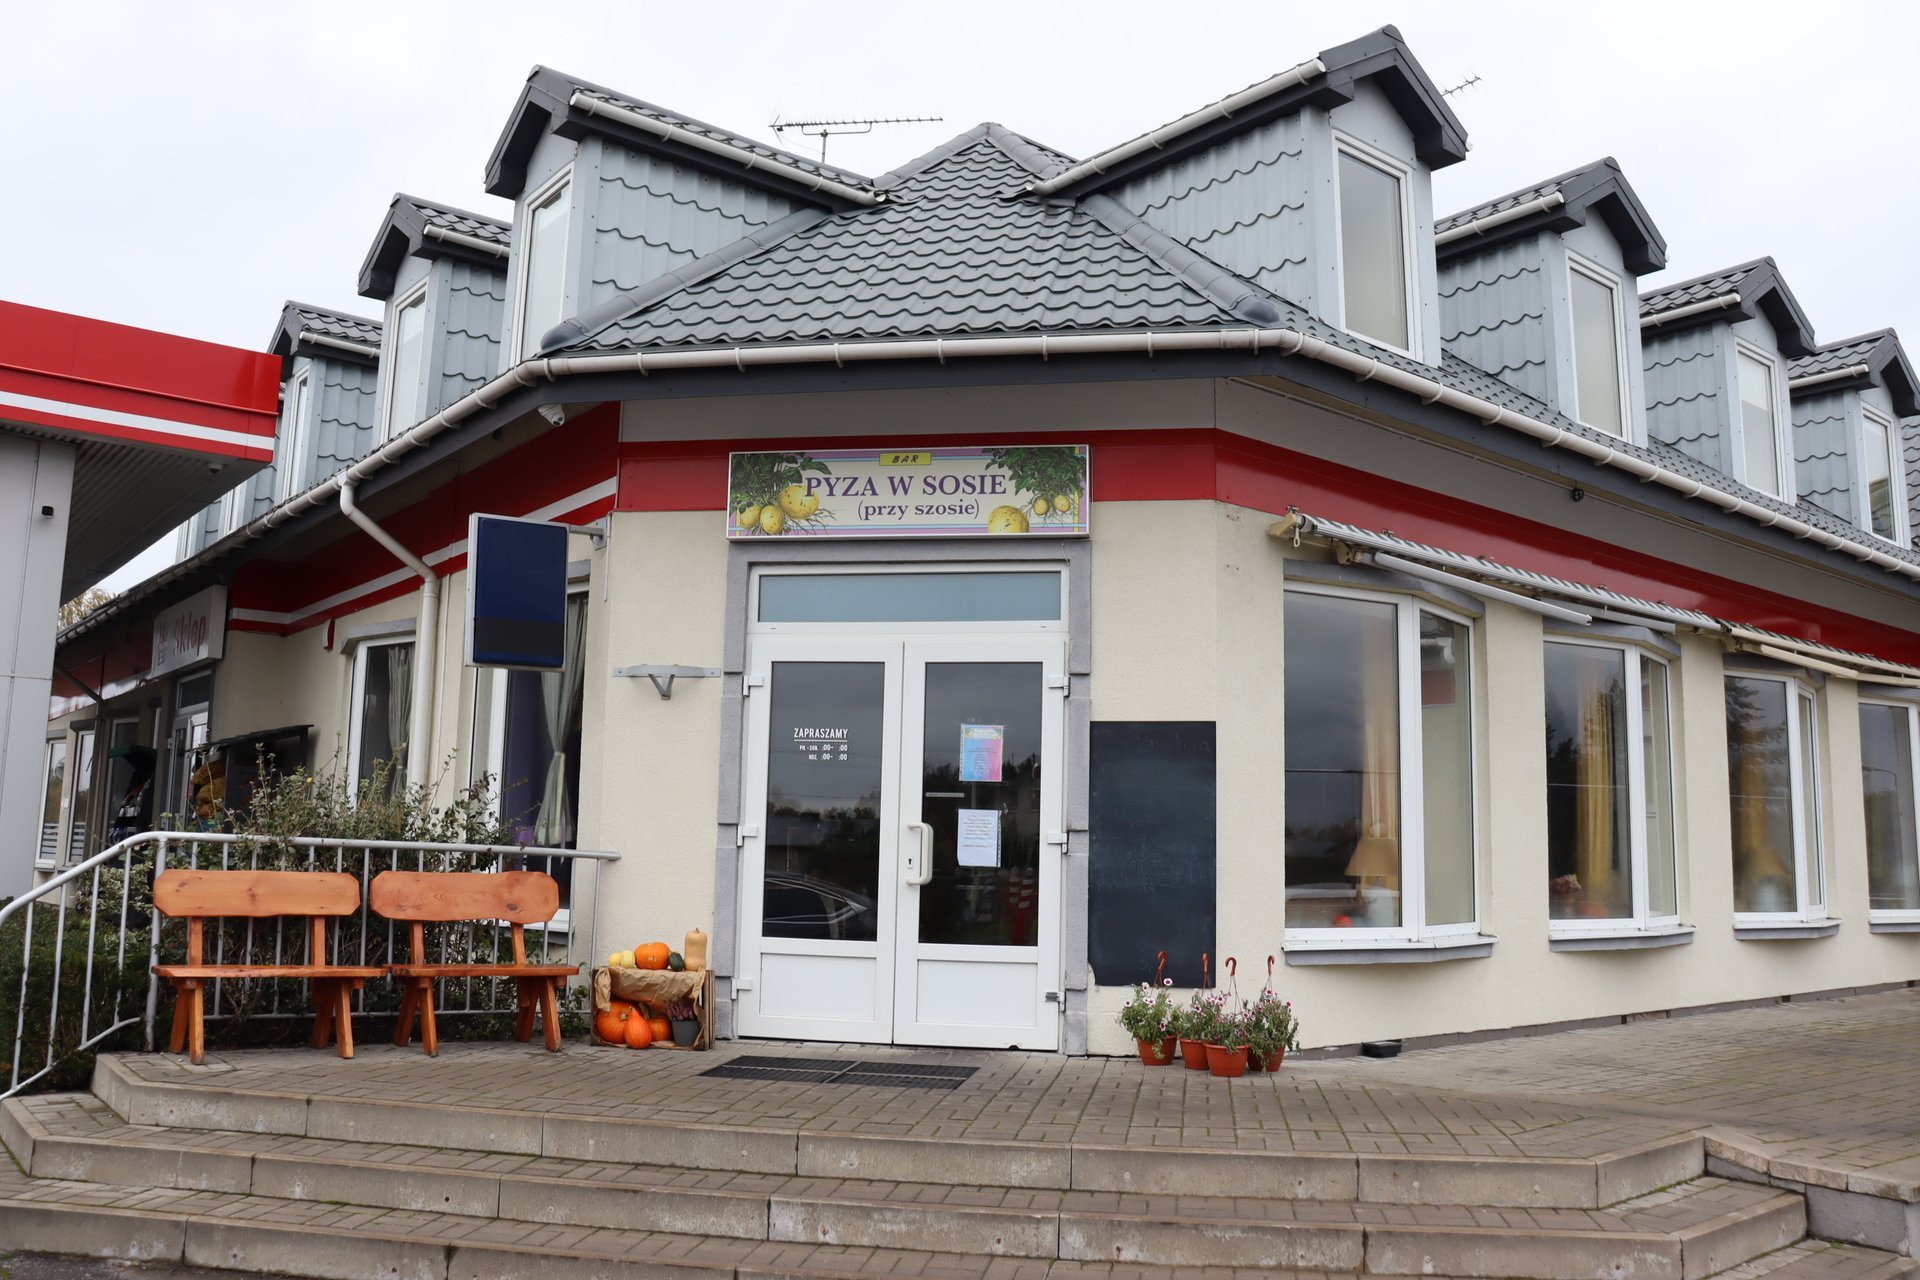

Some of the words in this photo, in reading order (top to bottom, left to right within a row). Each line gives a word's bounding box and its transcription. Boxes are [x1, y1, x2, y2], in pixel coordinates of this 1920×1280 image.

[892, 455, 920, 464] BAR
[804, 476, 879, 498] PYZA
[888, 475, 915, 497] W
[922, 474, 1007, 496] SOSIE
[858, 500, 909, 521] (przy
[914, 498, 980, 519] szosie)
[173, 609, 208, 657] Sklep
[793, 727, 848, 739] ZAPRASZAMY
